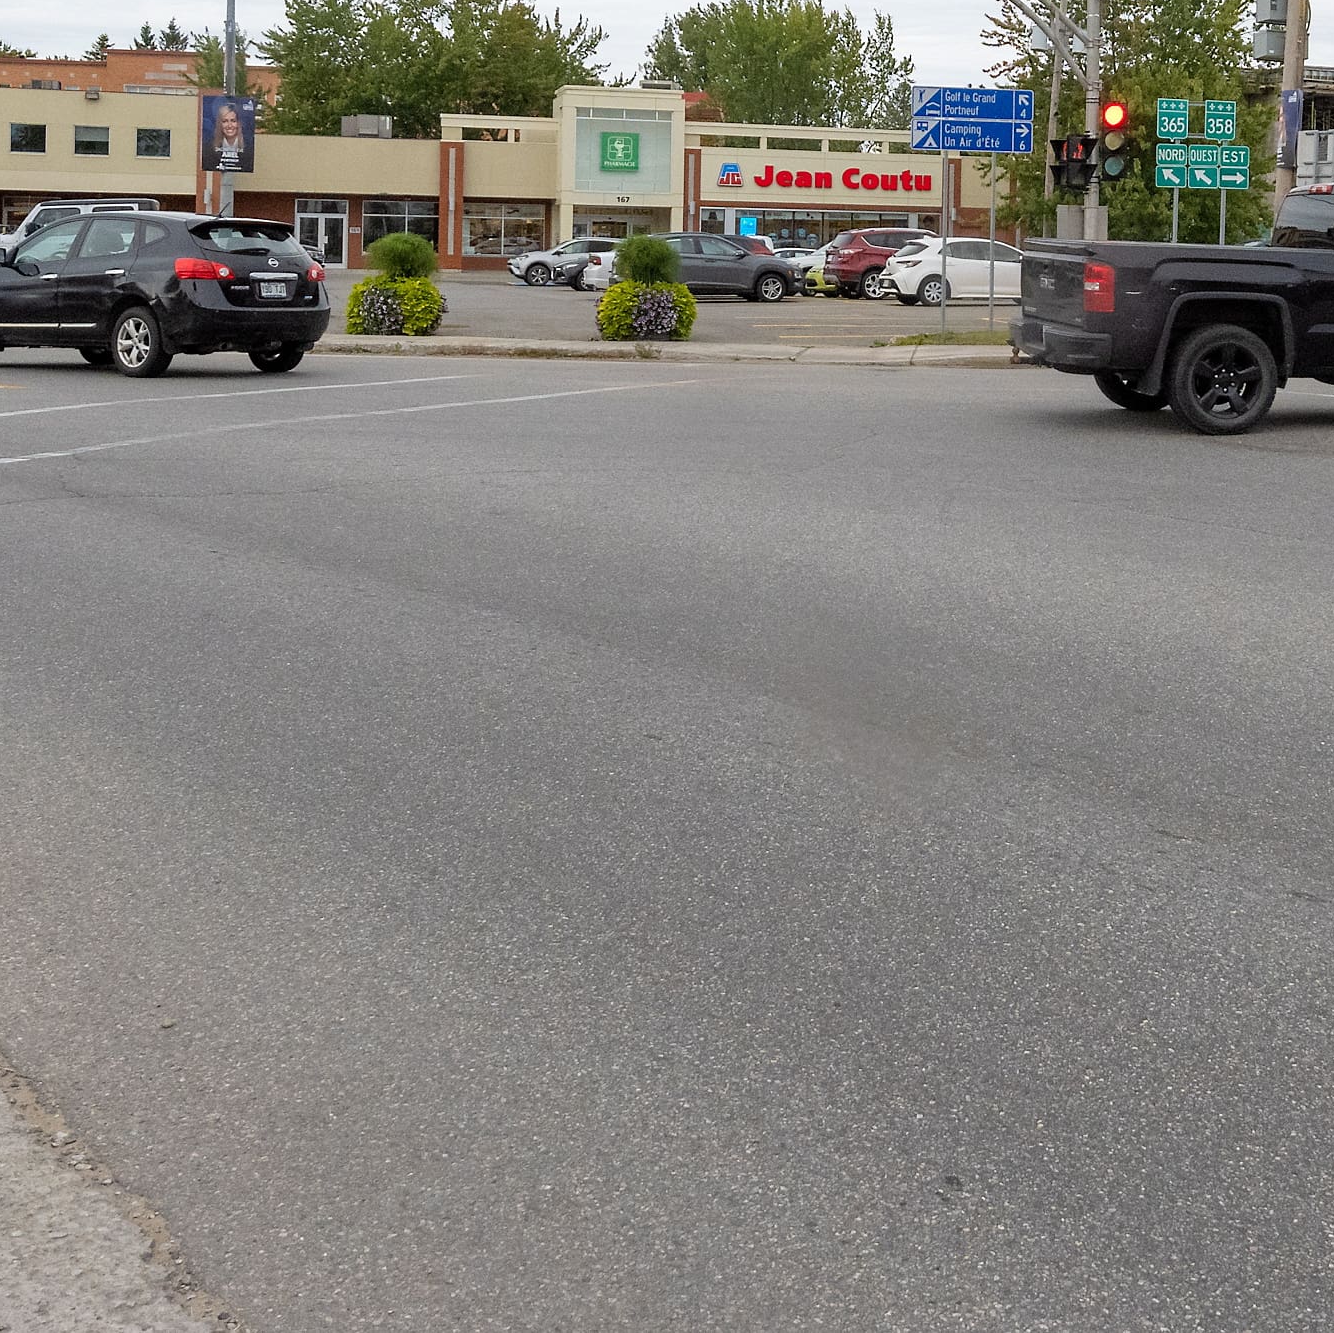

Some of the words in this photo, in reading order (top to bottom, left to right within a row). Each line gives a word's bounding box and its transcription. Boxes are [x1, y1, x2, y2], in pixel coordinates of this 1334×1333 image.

[945, 90, 961, 102] Golf
[963, 92, 971, 102] le
[972, 92, 996, 104] Grand
[944, 105, 979, 116] Portneuf
[1020, 109, 1027, 119] 4
[944, 123, 982, 137] Camping
[1160, 116, 1185, 133] 365
[1207, 118, 1233, 134] 358
[944, 137, 956, 147] Un
[959, 138, 972, 148] Air
[976, 136, 1000, 148] d'Été
[1019, 141, 1026, 150] 6
[1158, 149, 1185, 161] NORD
[1190, 149, 1218, 162] OUEST
[1222, 151, 1246, 163] EST
[753, 165, 833, 189] Jean
[841, 167, 932, 192] Coutu
